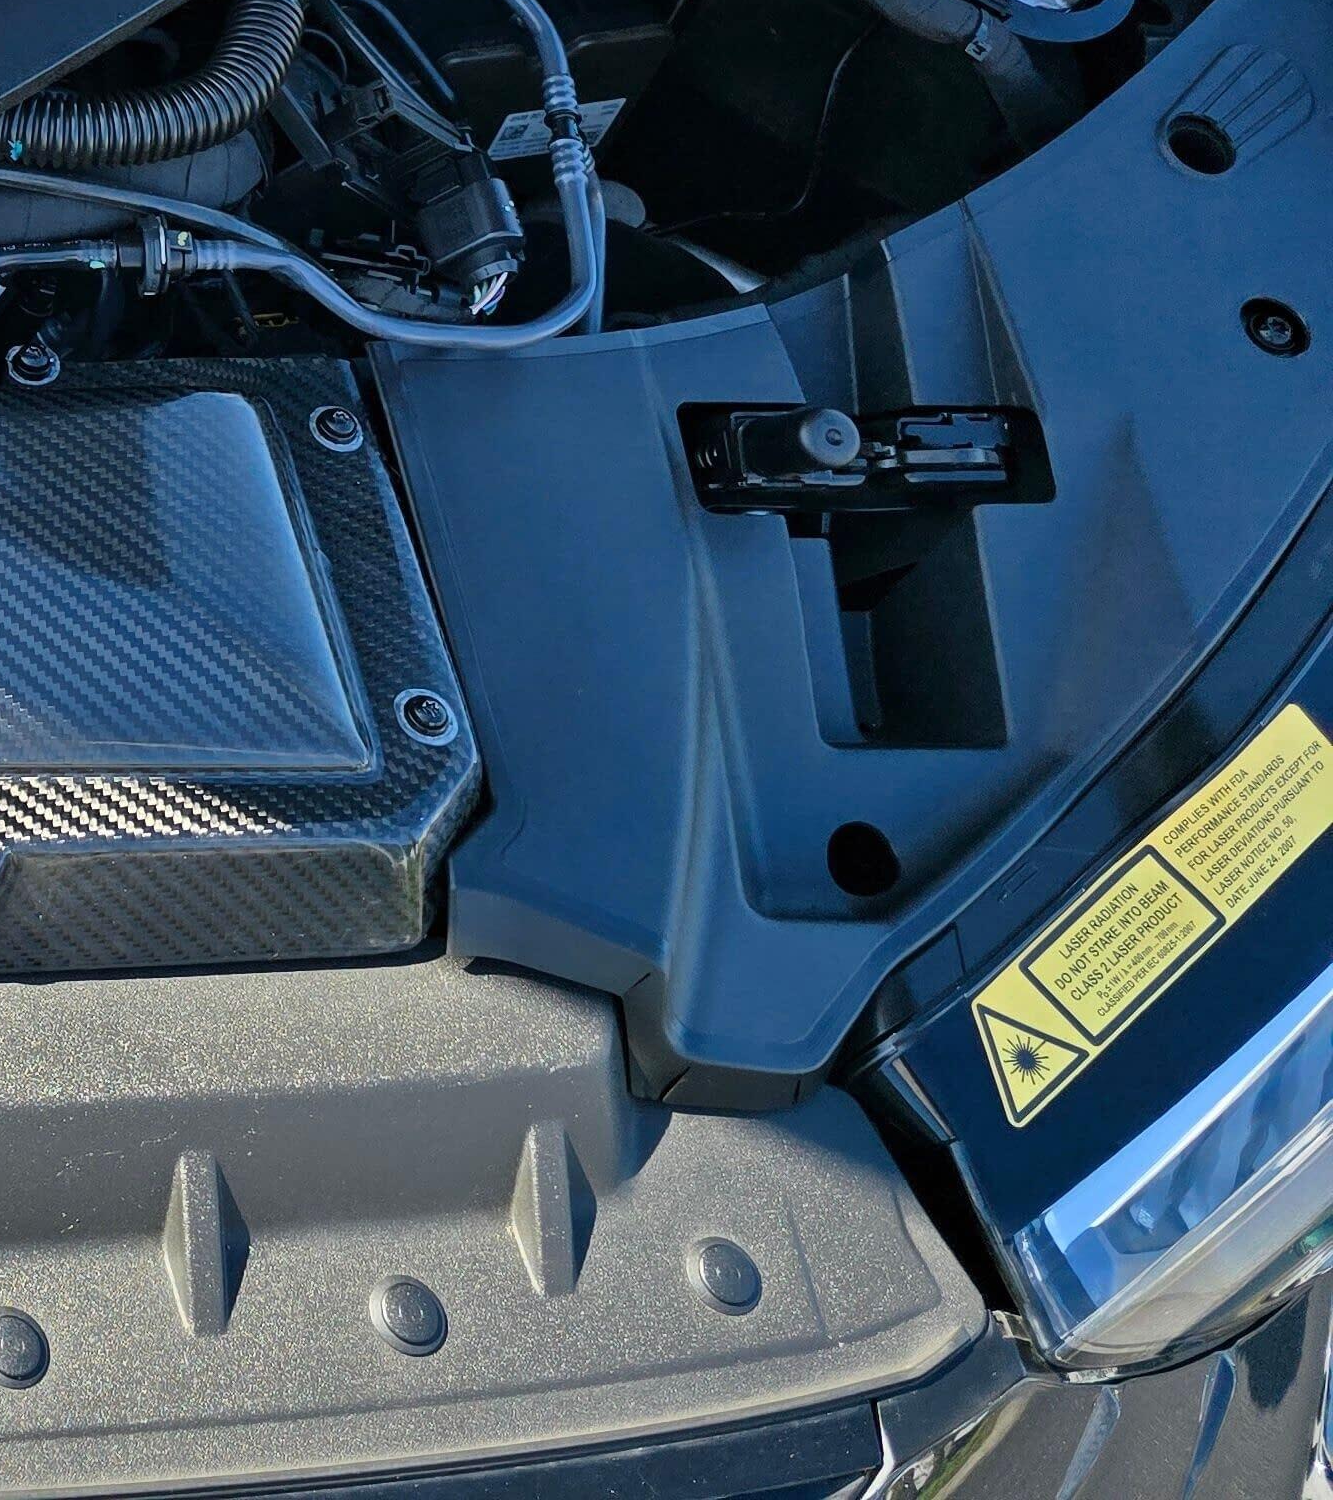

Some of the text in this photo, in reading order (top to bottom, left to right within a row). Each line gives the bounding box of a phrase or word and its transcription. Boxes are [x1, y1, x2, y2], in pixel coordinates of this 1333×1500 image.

[1161, 766, 1250, 847] COMPLIES WITH FDA
[1173, 753, 1288, 859] PERFORMANCE STANDARDS
[1186, 738, 1323, 872] FOR LASER PRODUCTS EXCEPT FOR
[1199, 759, 1326, 884] LASER DEVIATIONS PURSUANT TO
[1212, 812, 1298, 896] LASER NOTICE NO. 50,
[1223, 882, 1251, 909] DATE
[1243, 862, 1270, 888] JUNE
[1275, 833, 1299, 857] 2007
[1052, 877, 1171, 991] DO NOT STARE INTO BEAM
[1057, 880, 1141, 960] LASER RADIATION
[1068, 891, 1185, 1003] CLASS 2 LASER PRODUCT
[1094, 977, 1138, 1018] CLASSIFIED
[1130, 965, 1149, 983] PER
[1144, 955, 1160, 971] IEC
